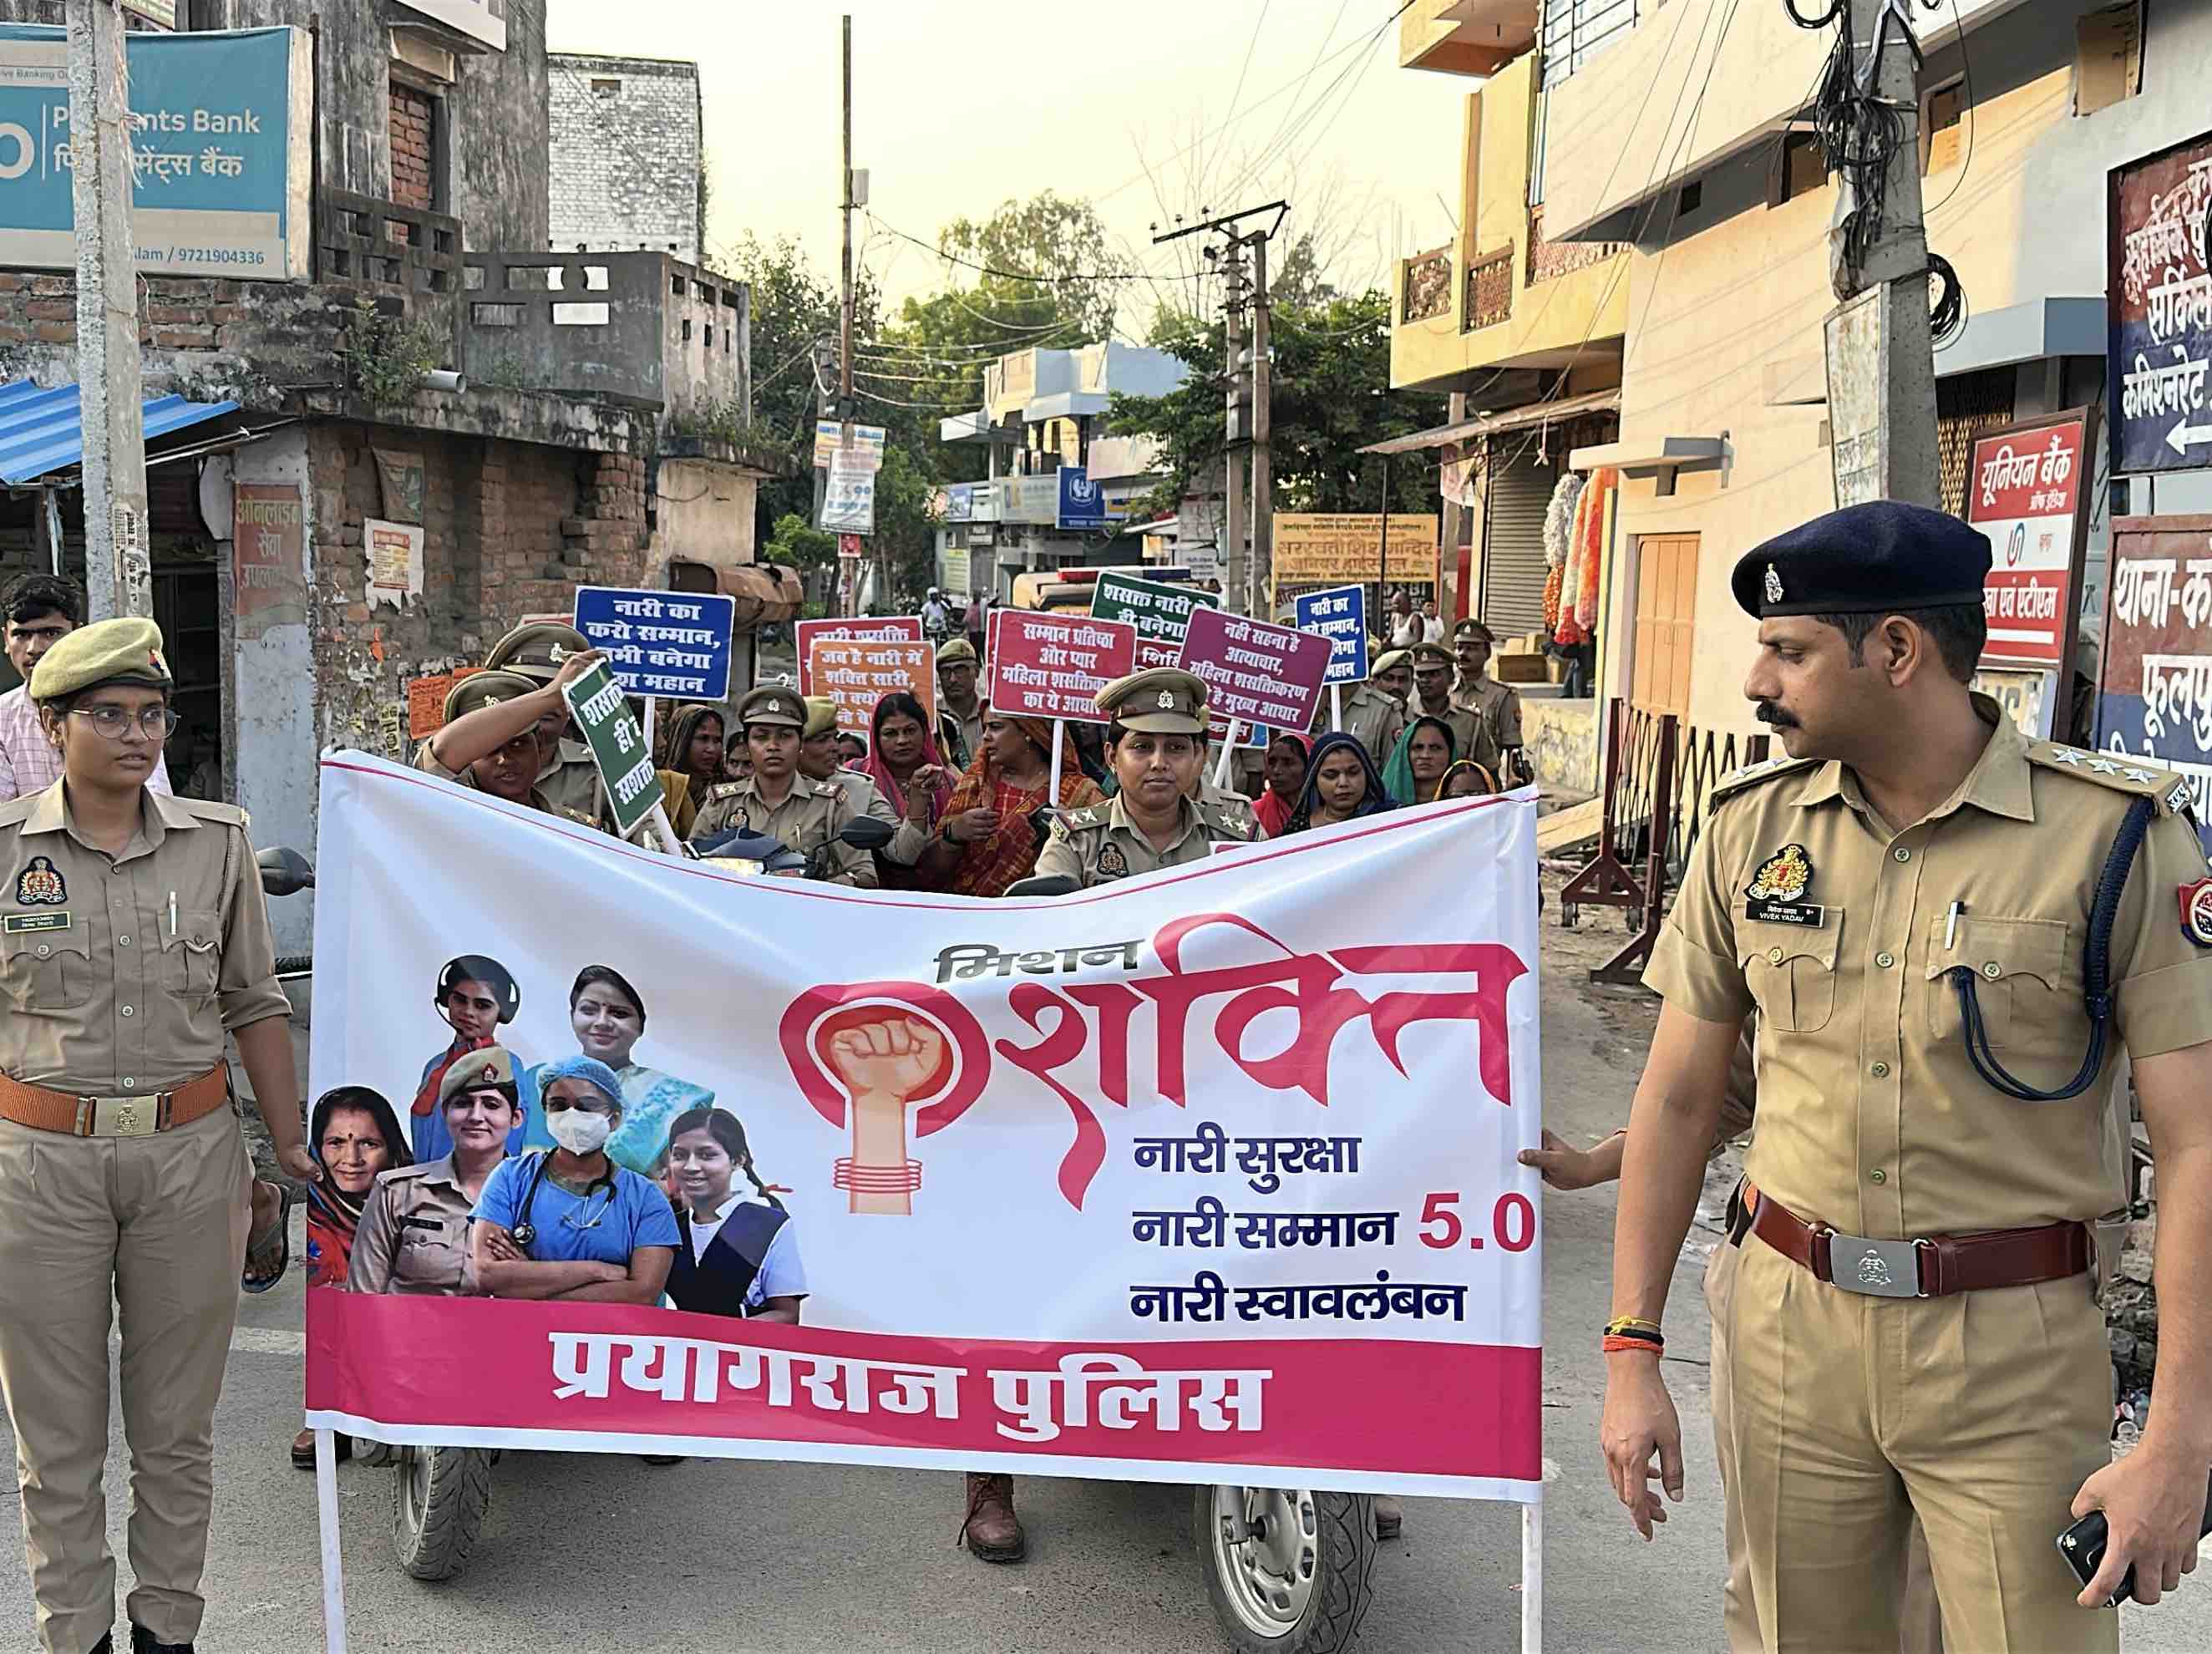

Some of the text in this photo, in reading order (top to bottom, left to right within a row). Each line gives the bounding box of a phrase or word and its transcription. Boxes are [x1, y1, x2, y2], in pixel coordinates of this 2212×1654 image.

[193, 108, 261, 134] Bank
[200, 145, 244, 177] बैंक
[179, 248, 265, 265] 9721904336
[2122, 343, 2209, 420] कमिश्नरेट
[1981, 434, 2074, 508] यूनियन बैंक
[612, 597, 703, 621] नारी का
[1154, 596, 1192, 616] नारी
[1309, 596, 1350, 616] नारी का
[1999, 576, 2017, 616] एवं
[2017, 576, 2058, 620] एटीएम
[586, 619, 722, 650] करो सम्मान,
[1022, 622, 1071, 644] सम्मान
[1139, 614, 1187, 639] बनेगा
[1251, 628, 1289, 652] सहना
[1289, 632, 1301, 653] है
[647, 647, 713, 669] बनेगा
[865, 648, 903, 667] नारी
[1039, 644, 1098, 669] और प्यार
[613, 671, 707, 693] श महान
[1002, 663, 1049, 687] महिला
[1190, 659, 1235, 685] महिला
[1022, 691, 1044, 709] का
[1046, 689, 1061, 711] ये
[1211, 685, 1225, 706] है
[1225, 693, 1261, 714] मुख्य
[1759, 912, 1781, 921] VIVEK
[932, 937, 1146, 984] मिशन
[994, 911, 1530, 1214] शक्ति
[1132, 1120, 1363, 1195] नारी सुरक्षा
[1131, 1190, 1537, 1254] नारी सम्मान 5.0
[1129, 1269, 1469, 1323] नारी स्वावलंबन
[547, 1331, 1274, 1443] प्रयागराज पुलिस
